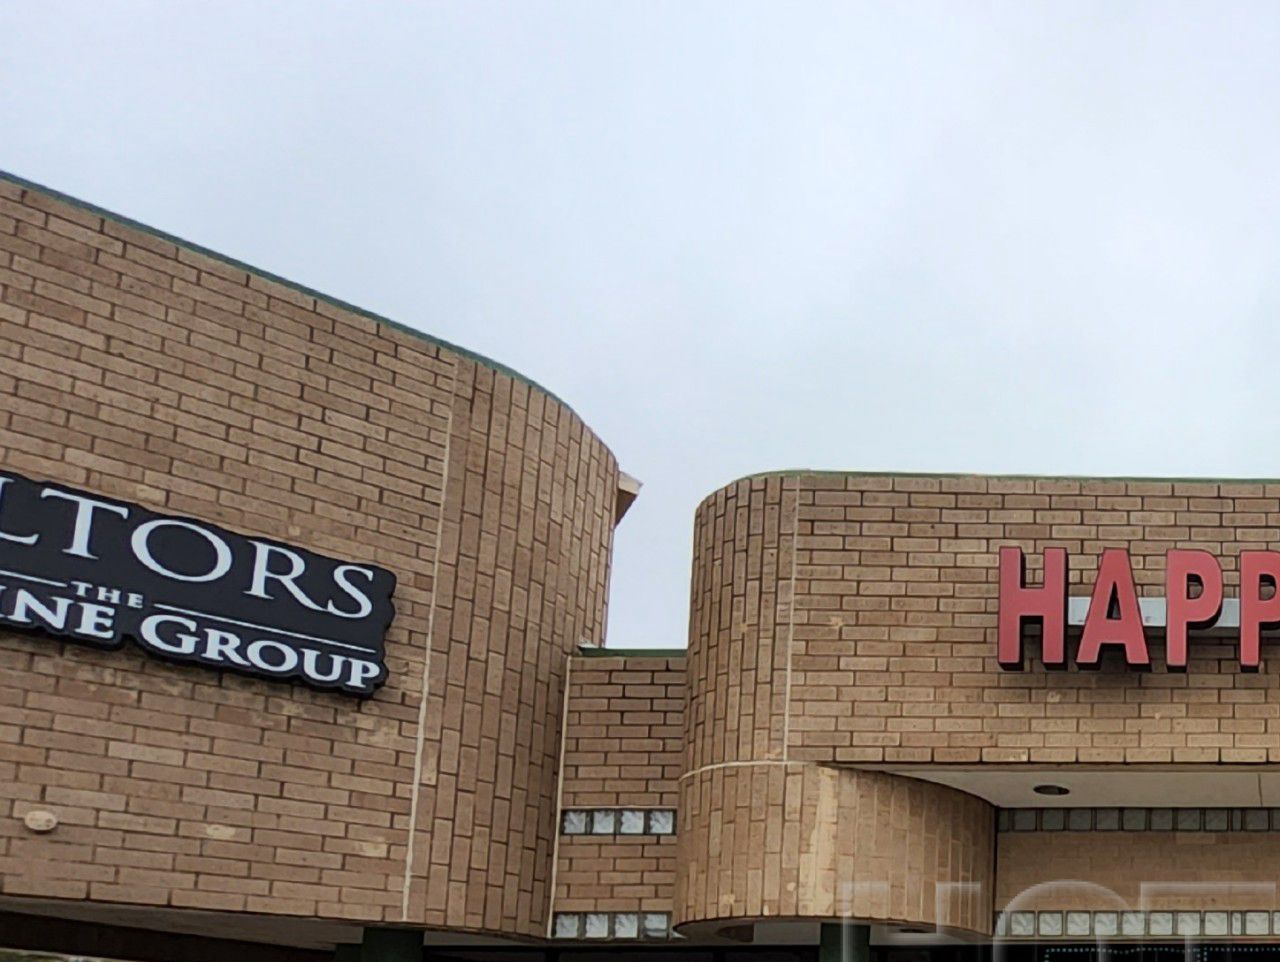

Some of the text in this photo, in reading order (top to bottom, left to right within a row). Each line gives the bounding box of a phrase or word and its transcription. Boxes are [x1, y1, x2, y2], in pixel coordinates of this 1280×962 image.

[71, 581, 143, 609] THE
[0, 585, 381, 688] NE GROUP
